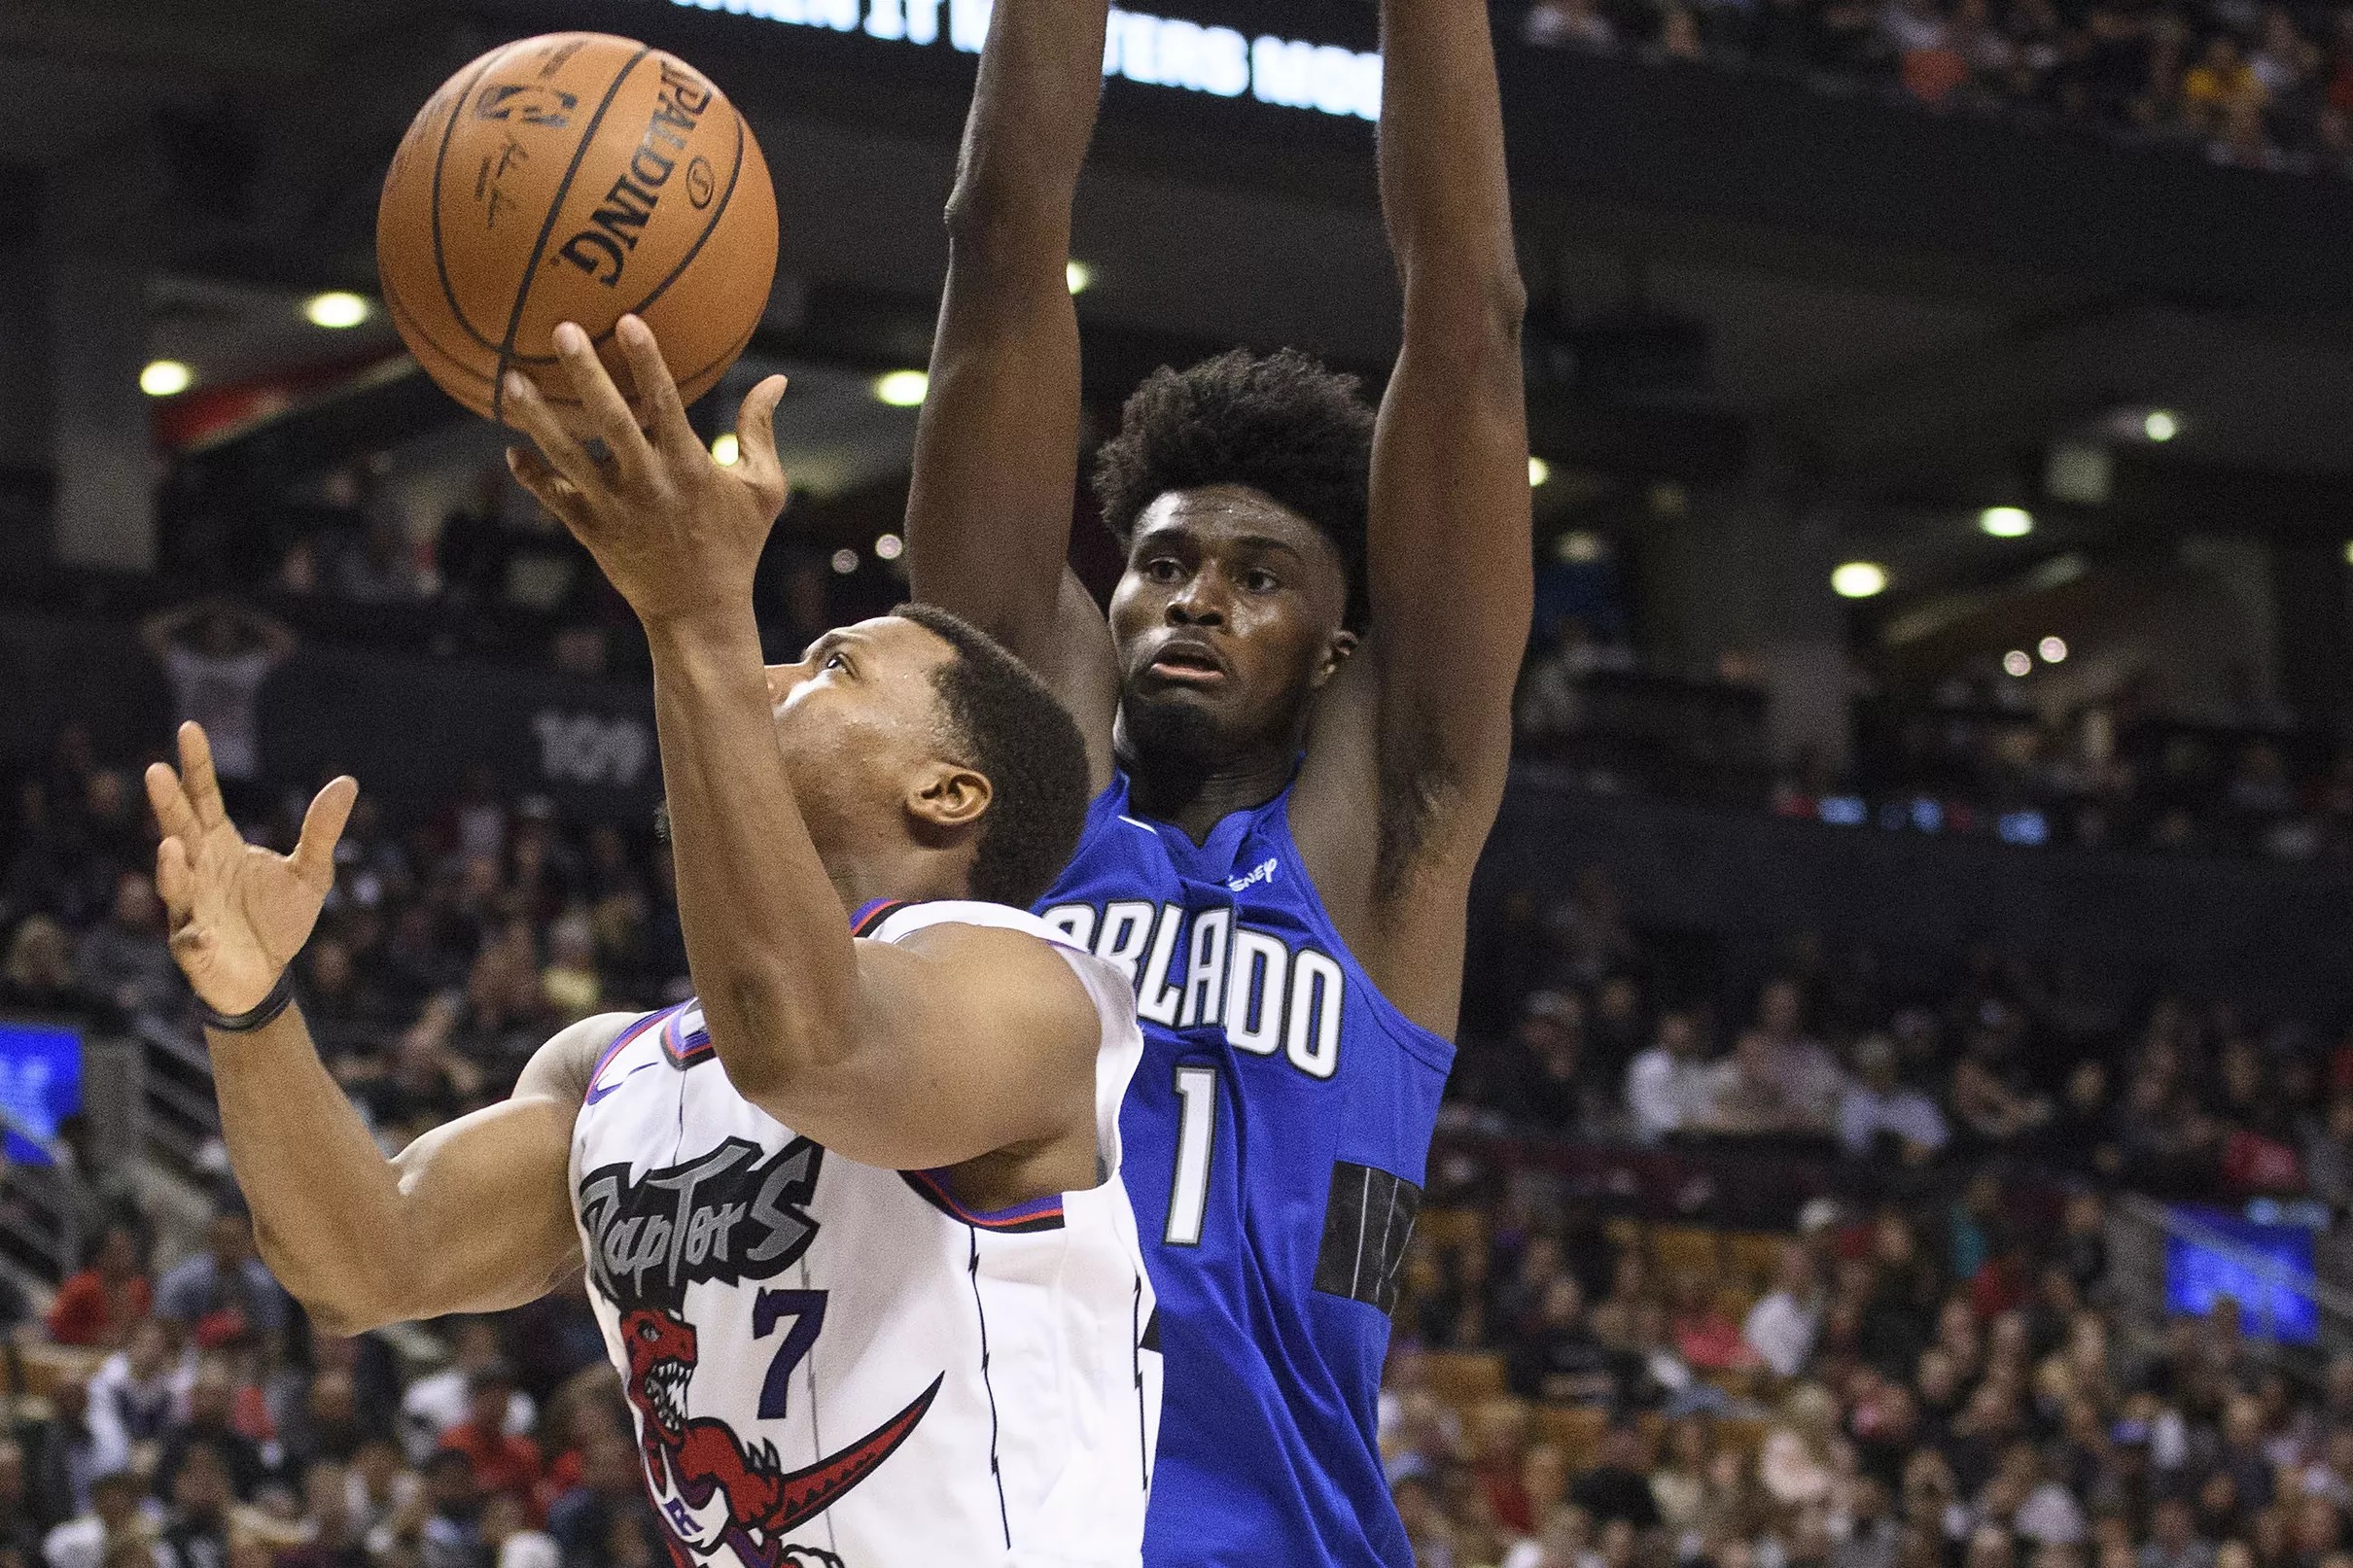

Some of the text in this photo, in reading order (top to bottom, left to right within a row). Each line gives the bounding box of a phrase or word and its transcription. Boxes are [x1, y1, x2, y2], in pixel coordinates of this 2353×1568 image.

[559, 58, 713, 287] PALDING
[1038, 899, 1348, 1080] RLADO
[1167, 1065, 1217, 1246] 1
[753, 1286, 829, 1420] 7
[663, 1497, 705, 1537] R
